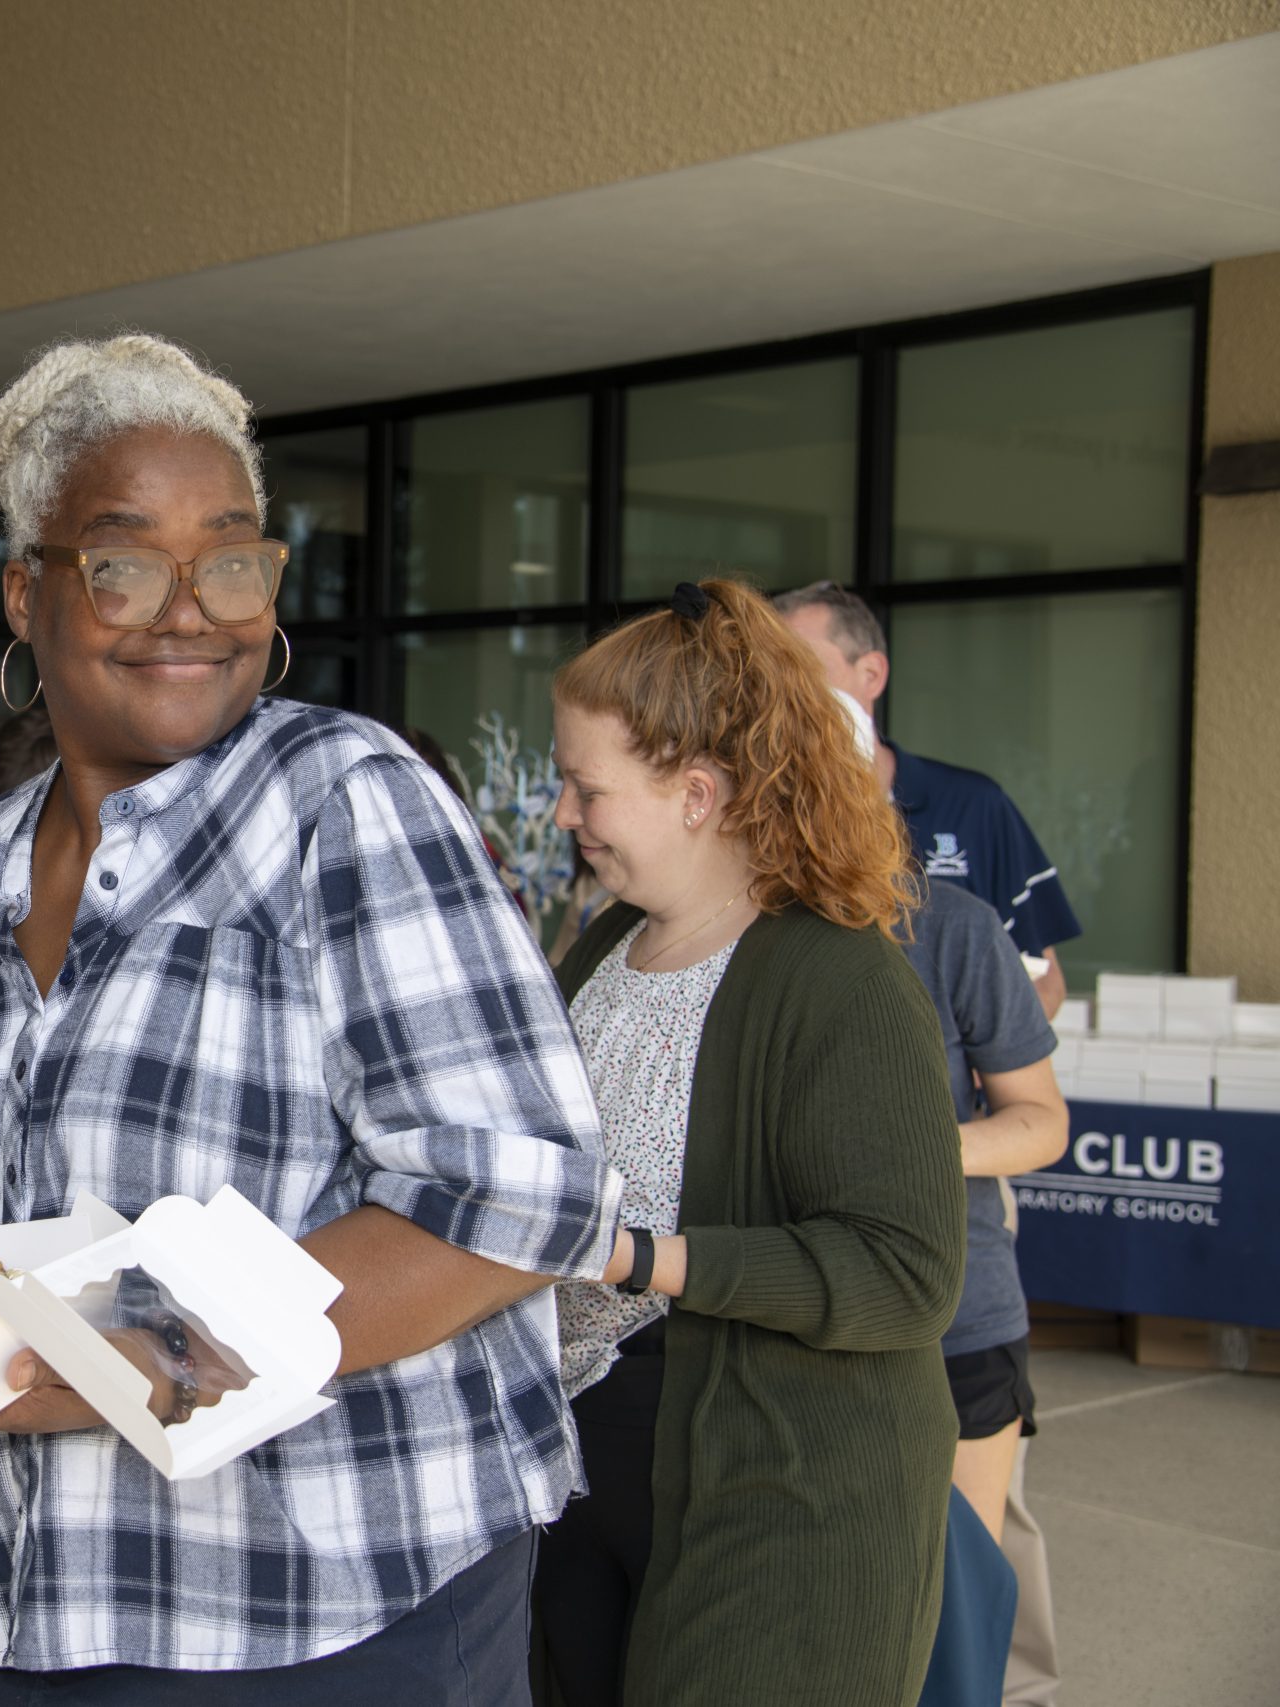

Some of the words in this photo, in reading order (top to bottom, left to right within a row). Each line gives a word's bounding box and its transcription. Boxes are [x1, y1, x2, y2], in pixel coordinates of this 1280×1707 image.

[1073, 1131, 1224, 1184] CLUB
[1013, 1187, 1108, 1217] RATORY
[1112, 1196, 1220, 1227] SCHOOL
